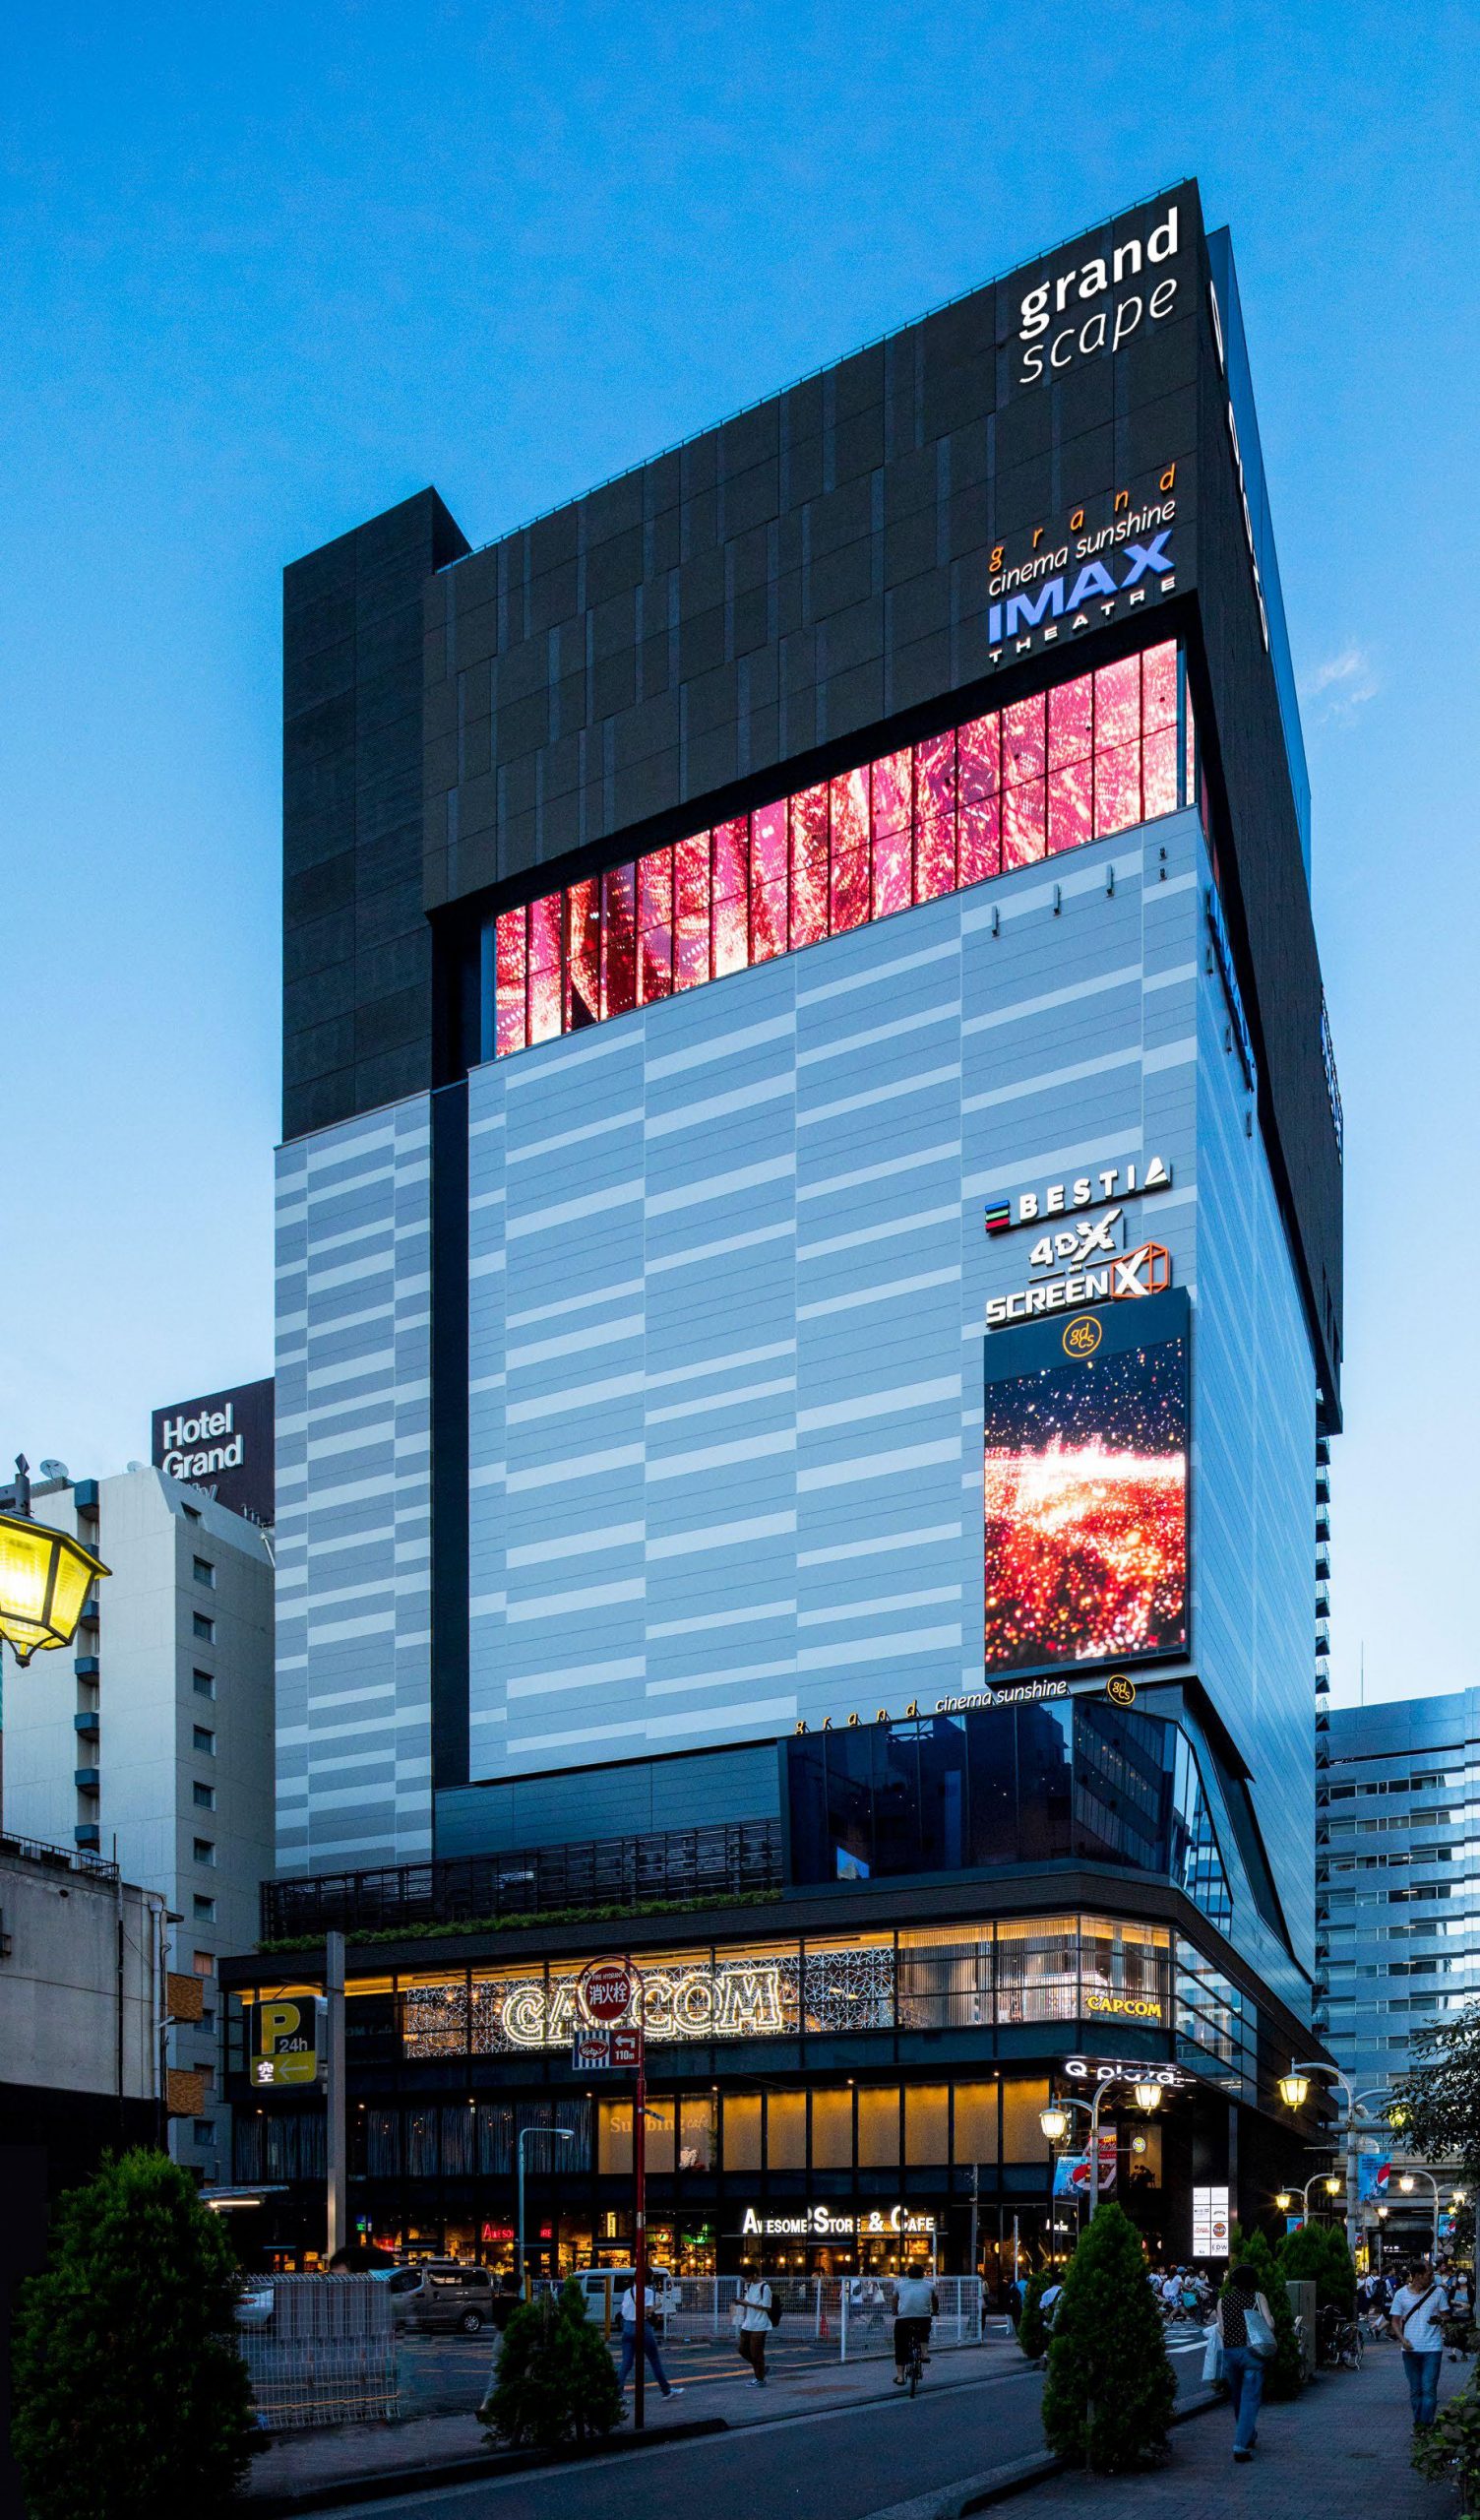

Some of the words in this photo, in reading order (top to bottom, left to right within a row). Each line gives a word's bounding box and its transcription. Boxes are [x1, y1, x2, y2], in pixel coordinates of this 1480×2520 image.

[1019, 206, 1178, 340] grand
[1019, 279, 1178, 383] scape
[989, 546, 1069, 597] cinema
[1076, 500, 1176, 559] sunshine
[989, 529, 1176, 645] IMAX
[989, 576, 1176, 664] THEATRE
[1019, 1157, 1170, 1222] BESTIA
[1029, 1208, 1123, 1266] 4DX
[163, 1402, 233, 1450] Hotel
[162, 1434, 243, 1480] Grand
[935, 1693, 993, 1713] cinema
[996, 1680, 1067, 1704] sunshine
[503, 1969, 783, 2046] CACOM
[589, 1982, 628, 2005] 消火栓
[1086, 1995, 1162, 2017] CAPCOM
[261, 2002, 301, 2055] P
[279, 2038, 308, 2053] 24h
[257, 2060, 275, 2082] 空
[615, 2050, 635, 2060] 110m
[1065, 2060, 1087, 2077] Q
[610, 2116, 686, 2134] Subin
[869, 2212, 885, 2232] &
